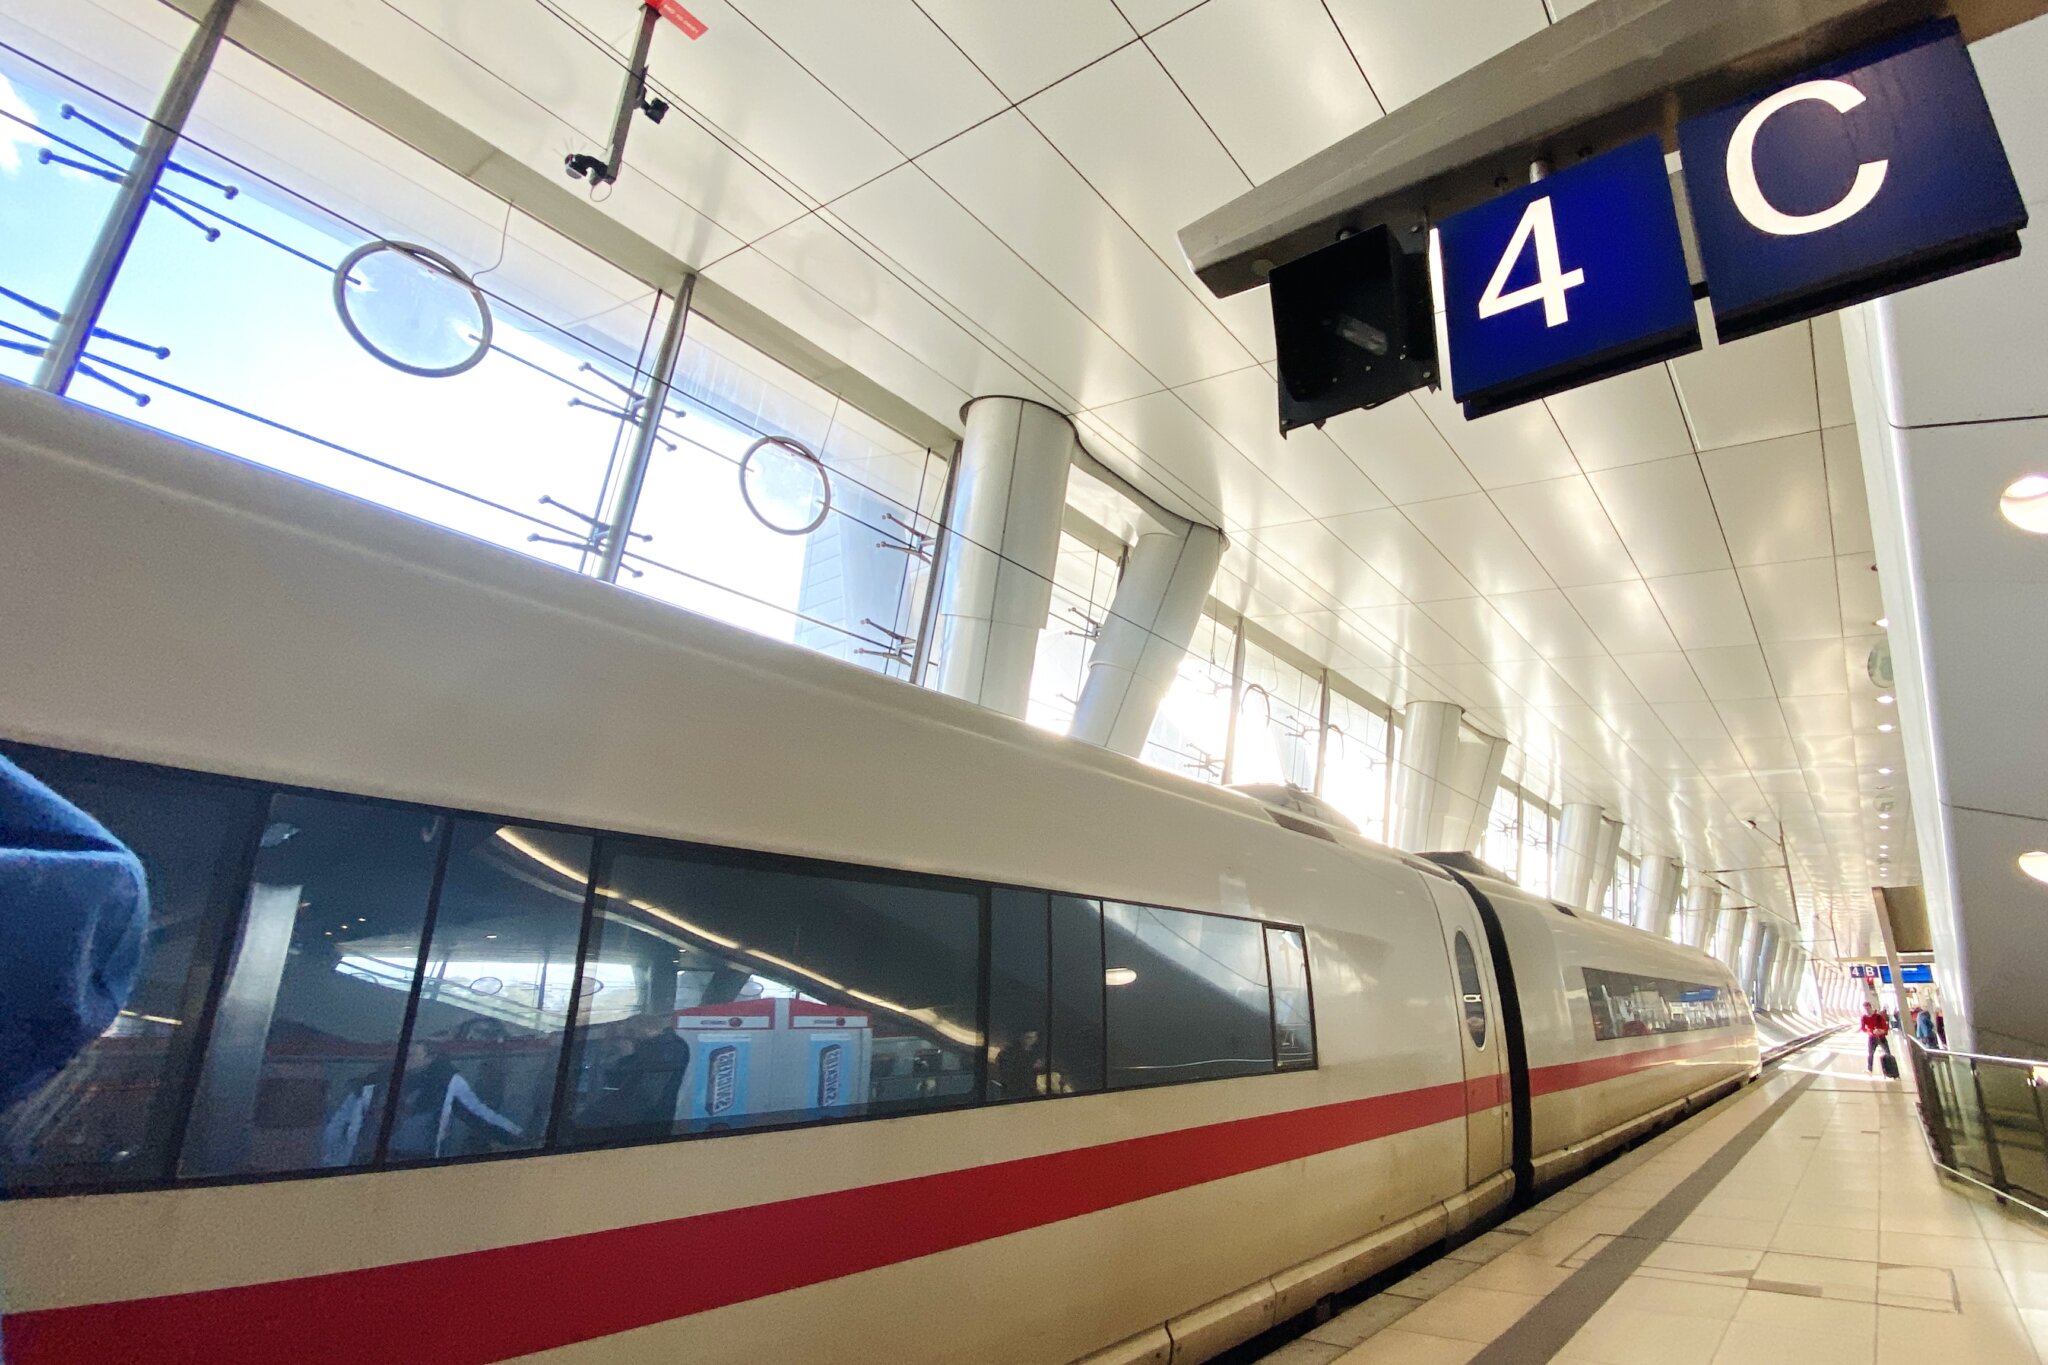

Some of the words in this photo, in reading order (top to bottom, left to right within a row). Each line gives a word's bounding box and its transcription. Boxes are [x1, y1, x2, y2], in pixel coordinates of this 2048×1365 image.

[1726, 79, 1889, 236] C
[1479, 195, 1585, 328] 4
[1852, 966, 1859, 976] 4
[1866, 966, 1874, 977] B
